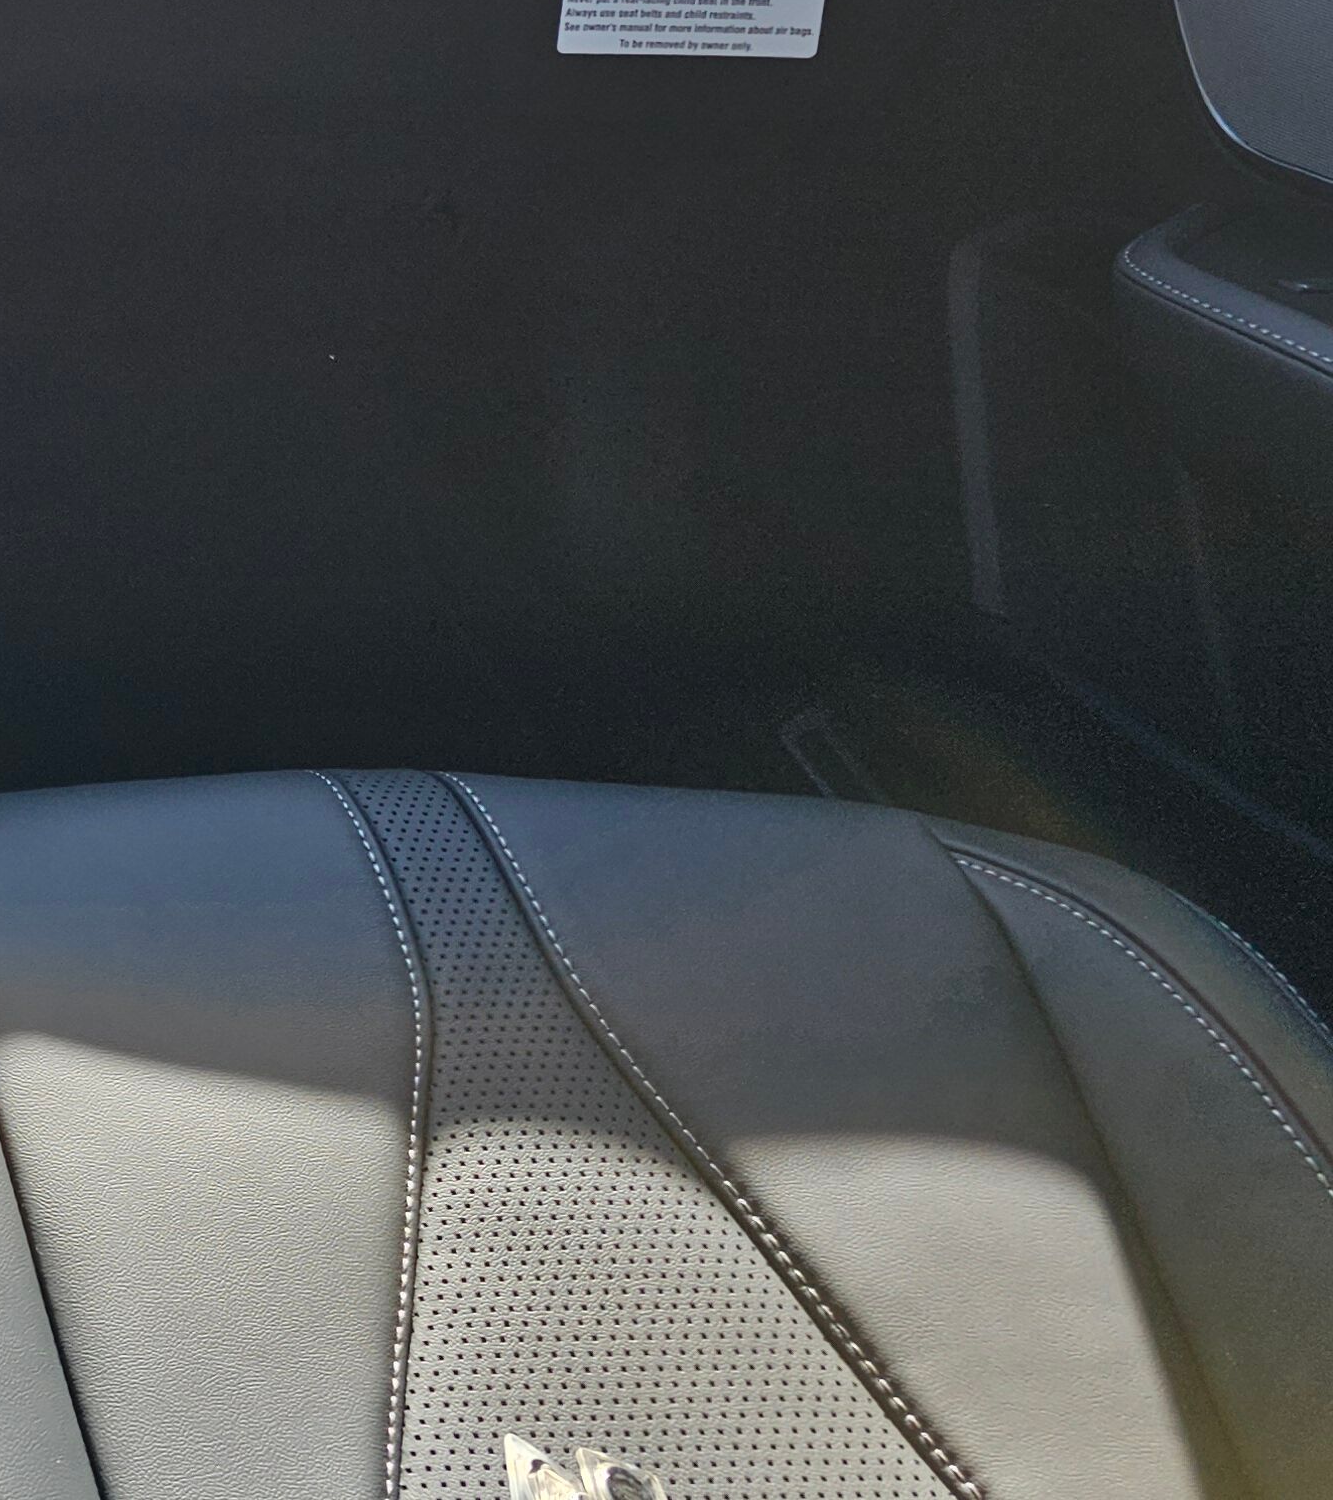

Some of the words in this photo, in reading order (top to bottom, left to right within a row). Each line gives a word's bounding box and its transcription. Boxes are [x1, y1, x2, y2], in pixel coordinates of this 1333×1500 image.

[565, 8, 597, 18] Always
[684, 10, 707, 19] child
[564, 22, 580, 31] See
[619, 23, 653, 32] manual
[654, 24, 667, 32] for
[694, 24, 746, 34] information
[747, 26, 774, 35] about
[619, 39, 630, 48] To
[631, 39, 643, 49] be
[645, 40, 686, 49] removed
[687, 40, 699, 50] by
[700, 42, 730, 50] owner
